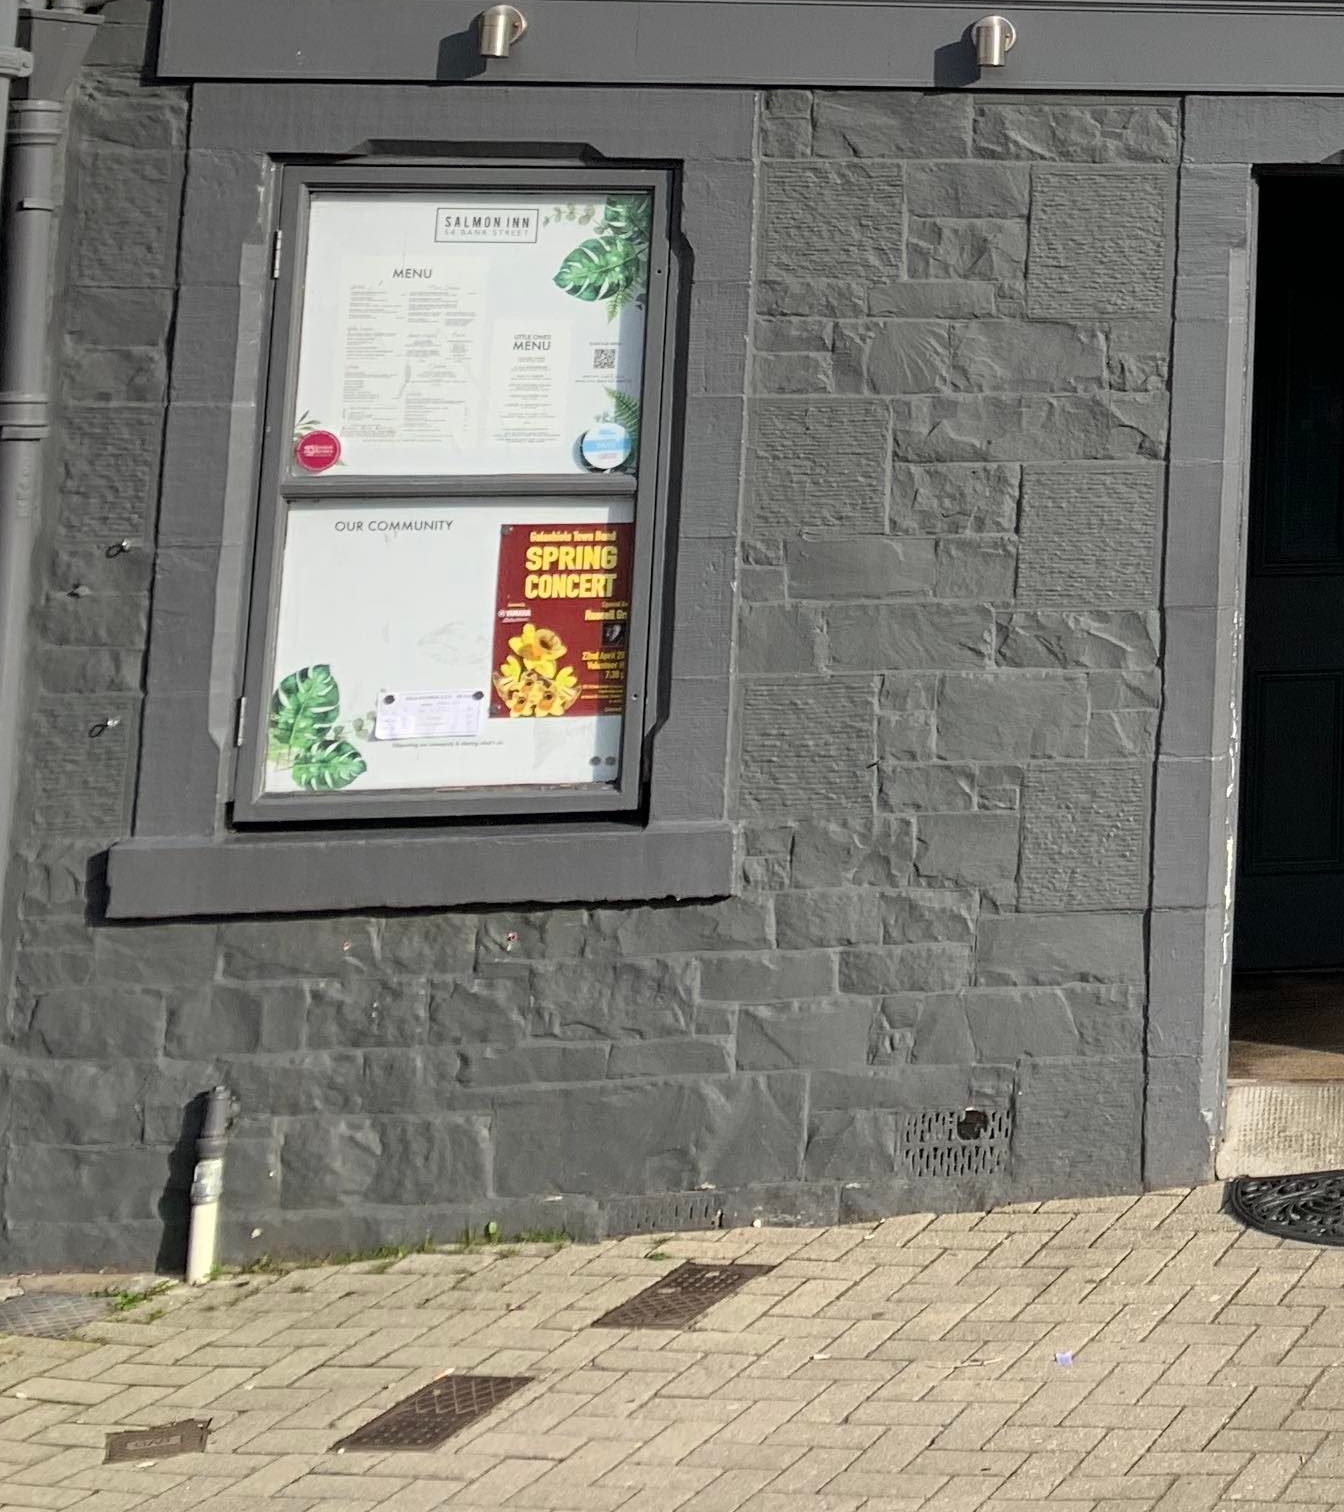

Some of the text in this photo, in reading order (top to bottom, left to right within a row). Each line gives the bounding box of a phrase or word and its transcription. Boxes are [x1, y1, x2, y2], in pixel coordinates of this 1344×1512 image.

[445, 216, 530, 228] SALMON INN
[392, 268, 432, 279] MENU
[512, 341, 551, 351] MENU
[335, 520, 454, 532] OUR COMMUNITY
[525, 545, 618, 571] SPRING
[524, 573, 617, 599] CONCERT
